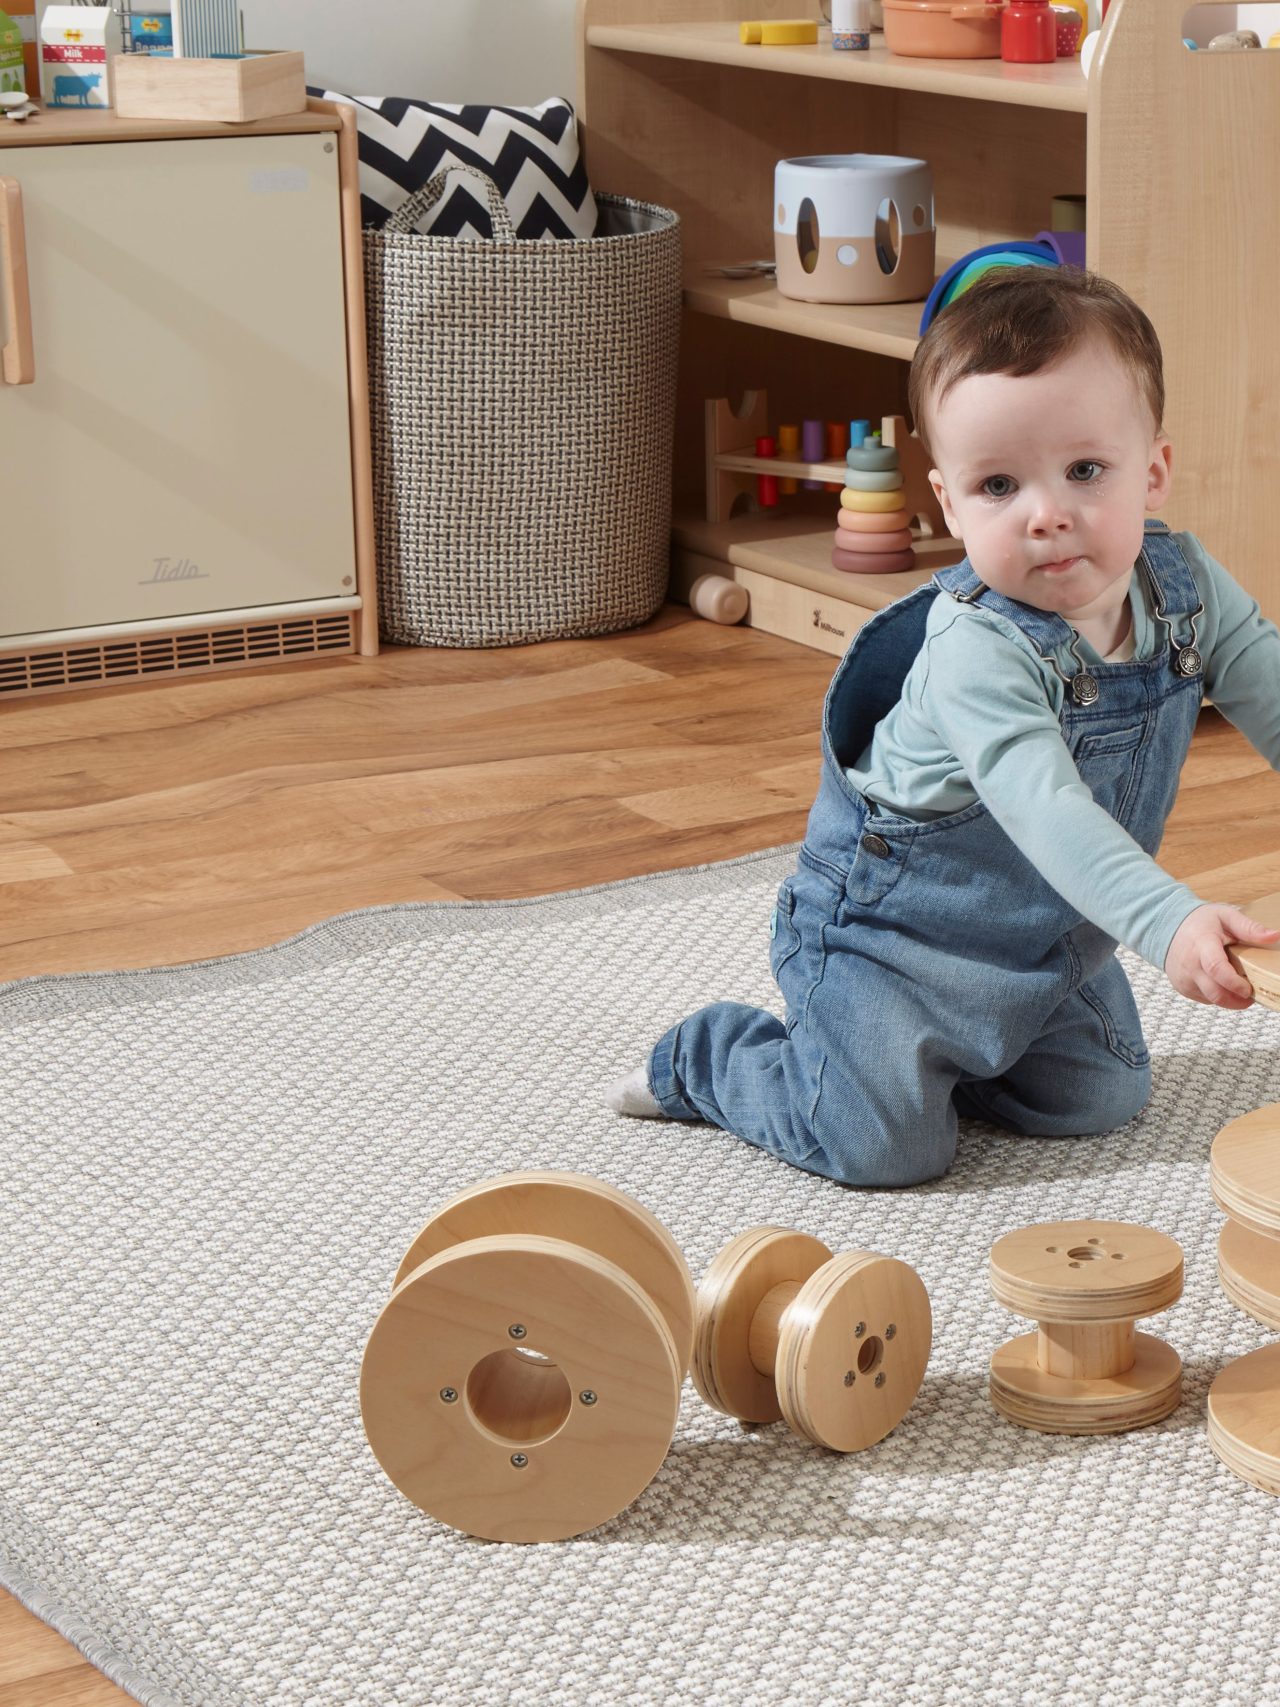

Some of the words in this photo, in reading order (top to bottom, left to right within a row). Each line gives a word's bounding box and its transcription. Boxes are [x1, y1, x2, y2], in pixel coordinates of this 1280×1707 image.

[63, 49, 83, 59] Milk
[149, 557, 202, 582] Tidlo
[820, 622, 845, 637] Millhouse
